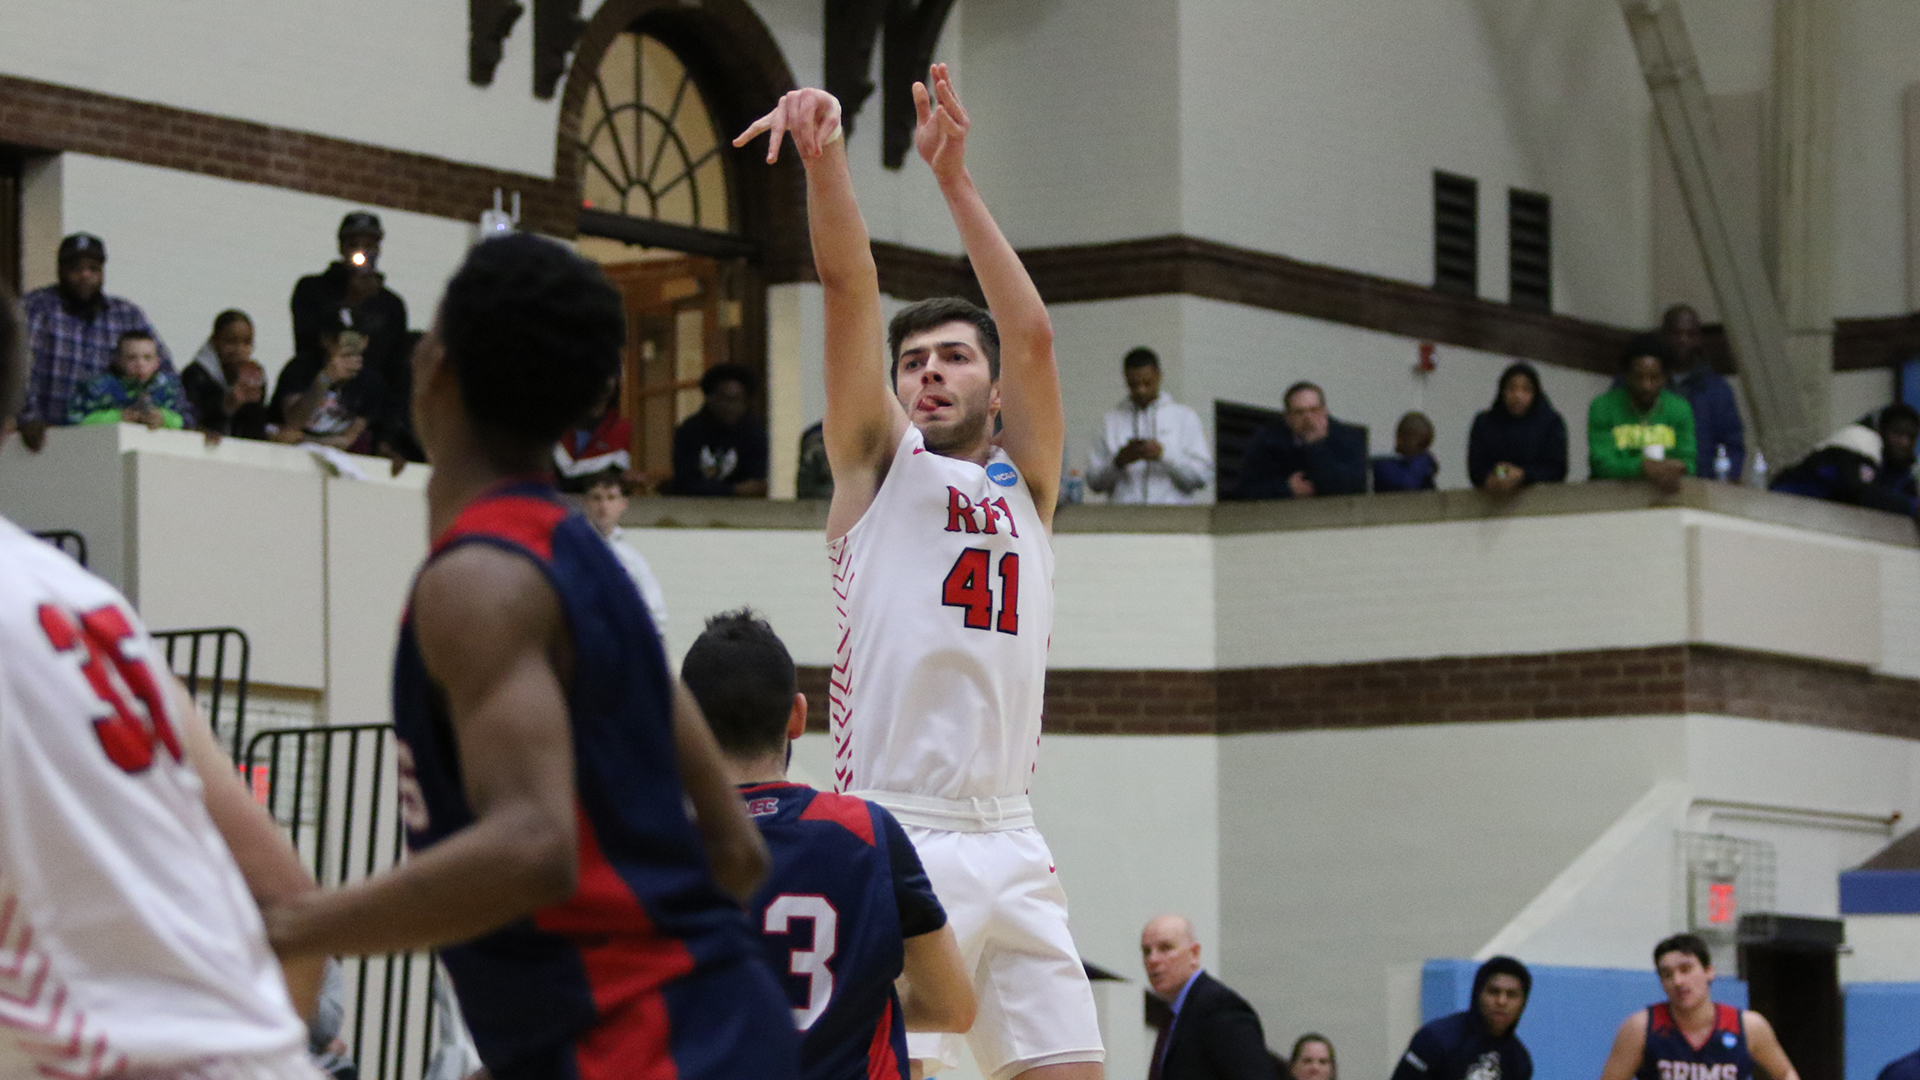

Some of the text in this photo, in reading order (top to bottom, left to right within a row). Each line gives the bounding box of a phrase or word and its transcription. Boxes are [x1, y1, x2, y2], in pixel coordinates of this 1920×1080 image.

[993, 470, 1017, 482] NCAA
[942, 547, 1020, 636] 41
[746, 797, 779, 817] EC
[763, 892, 839, 1033] 3
